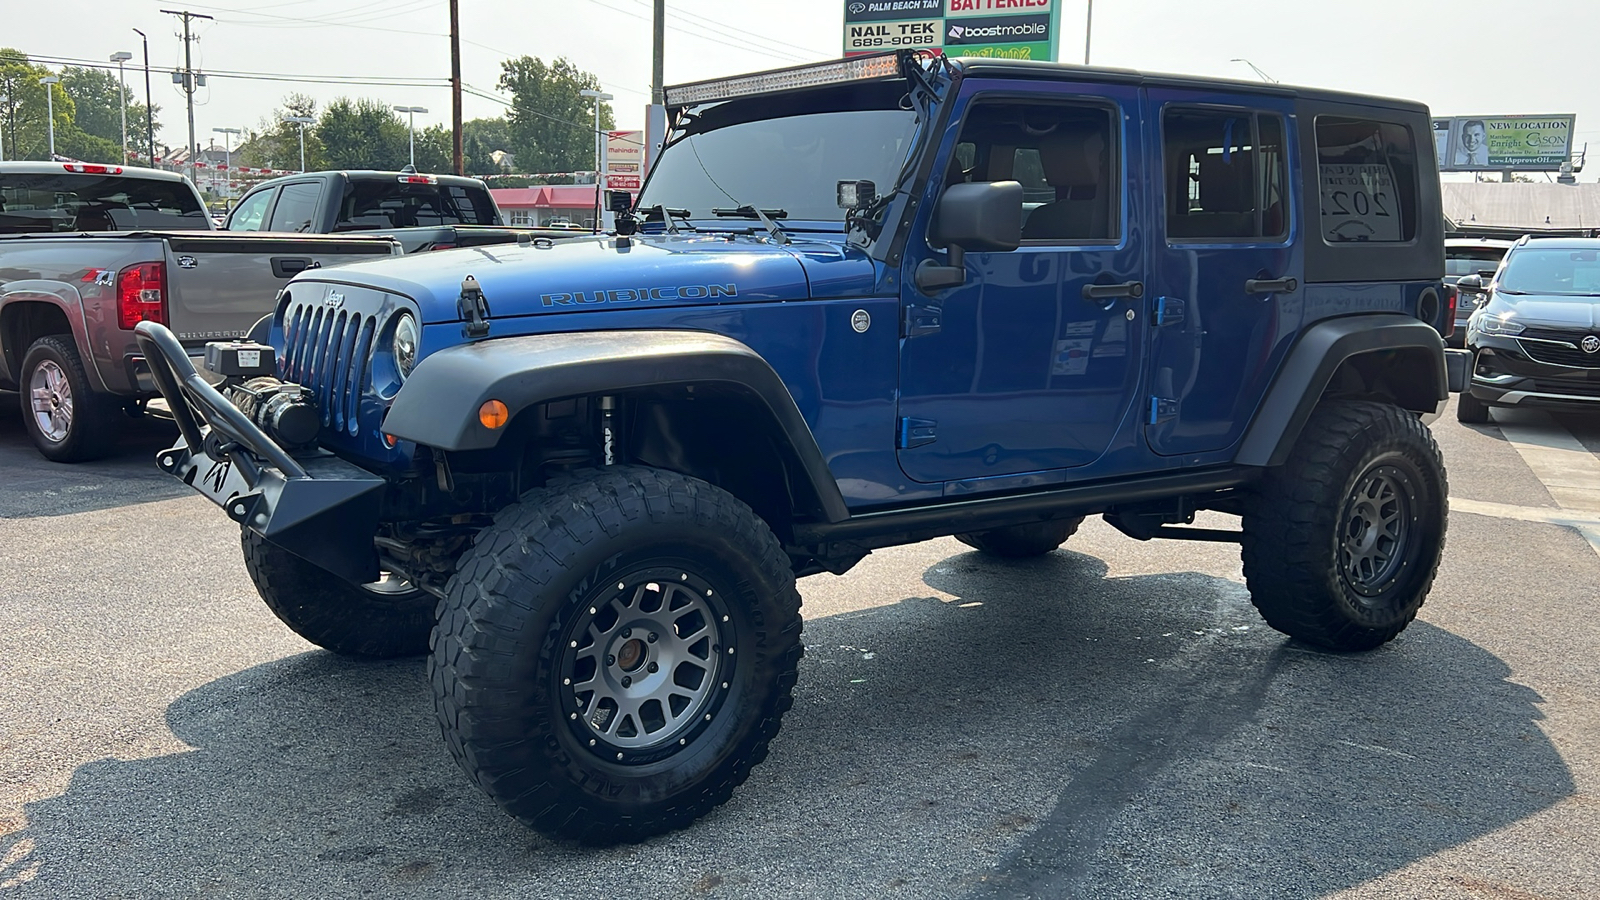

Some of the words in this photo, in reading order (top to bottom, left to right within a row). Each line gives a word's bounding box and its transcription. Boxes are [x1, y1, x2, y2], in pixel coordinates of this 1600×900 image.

[868, 2, 891, 12] PALM
[892, 1, 919, 10] BEACH
[922, 0, 940, 9] TAN
[850, 26, 891, 38] NAIL
[897, 22, 935, 35] TEK
[965, 23, 1047, 38] boostmobile
[852, 35, 934, 48] 689-9088
[1489, 122, 1513, 130] NEW
[1514, 121, 1568, 130] LOCATION
[1490, 139, 1522, 149] Enright
[81, 267, 116, 283] Z71
[325, 289, 344, 309] Jeep
[539, 283, 739, 307] RUBICON
[179, 331, 247, 340] SILVERADO
